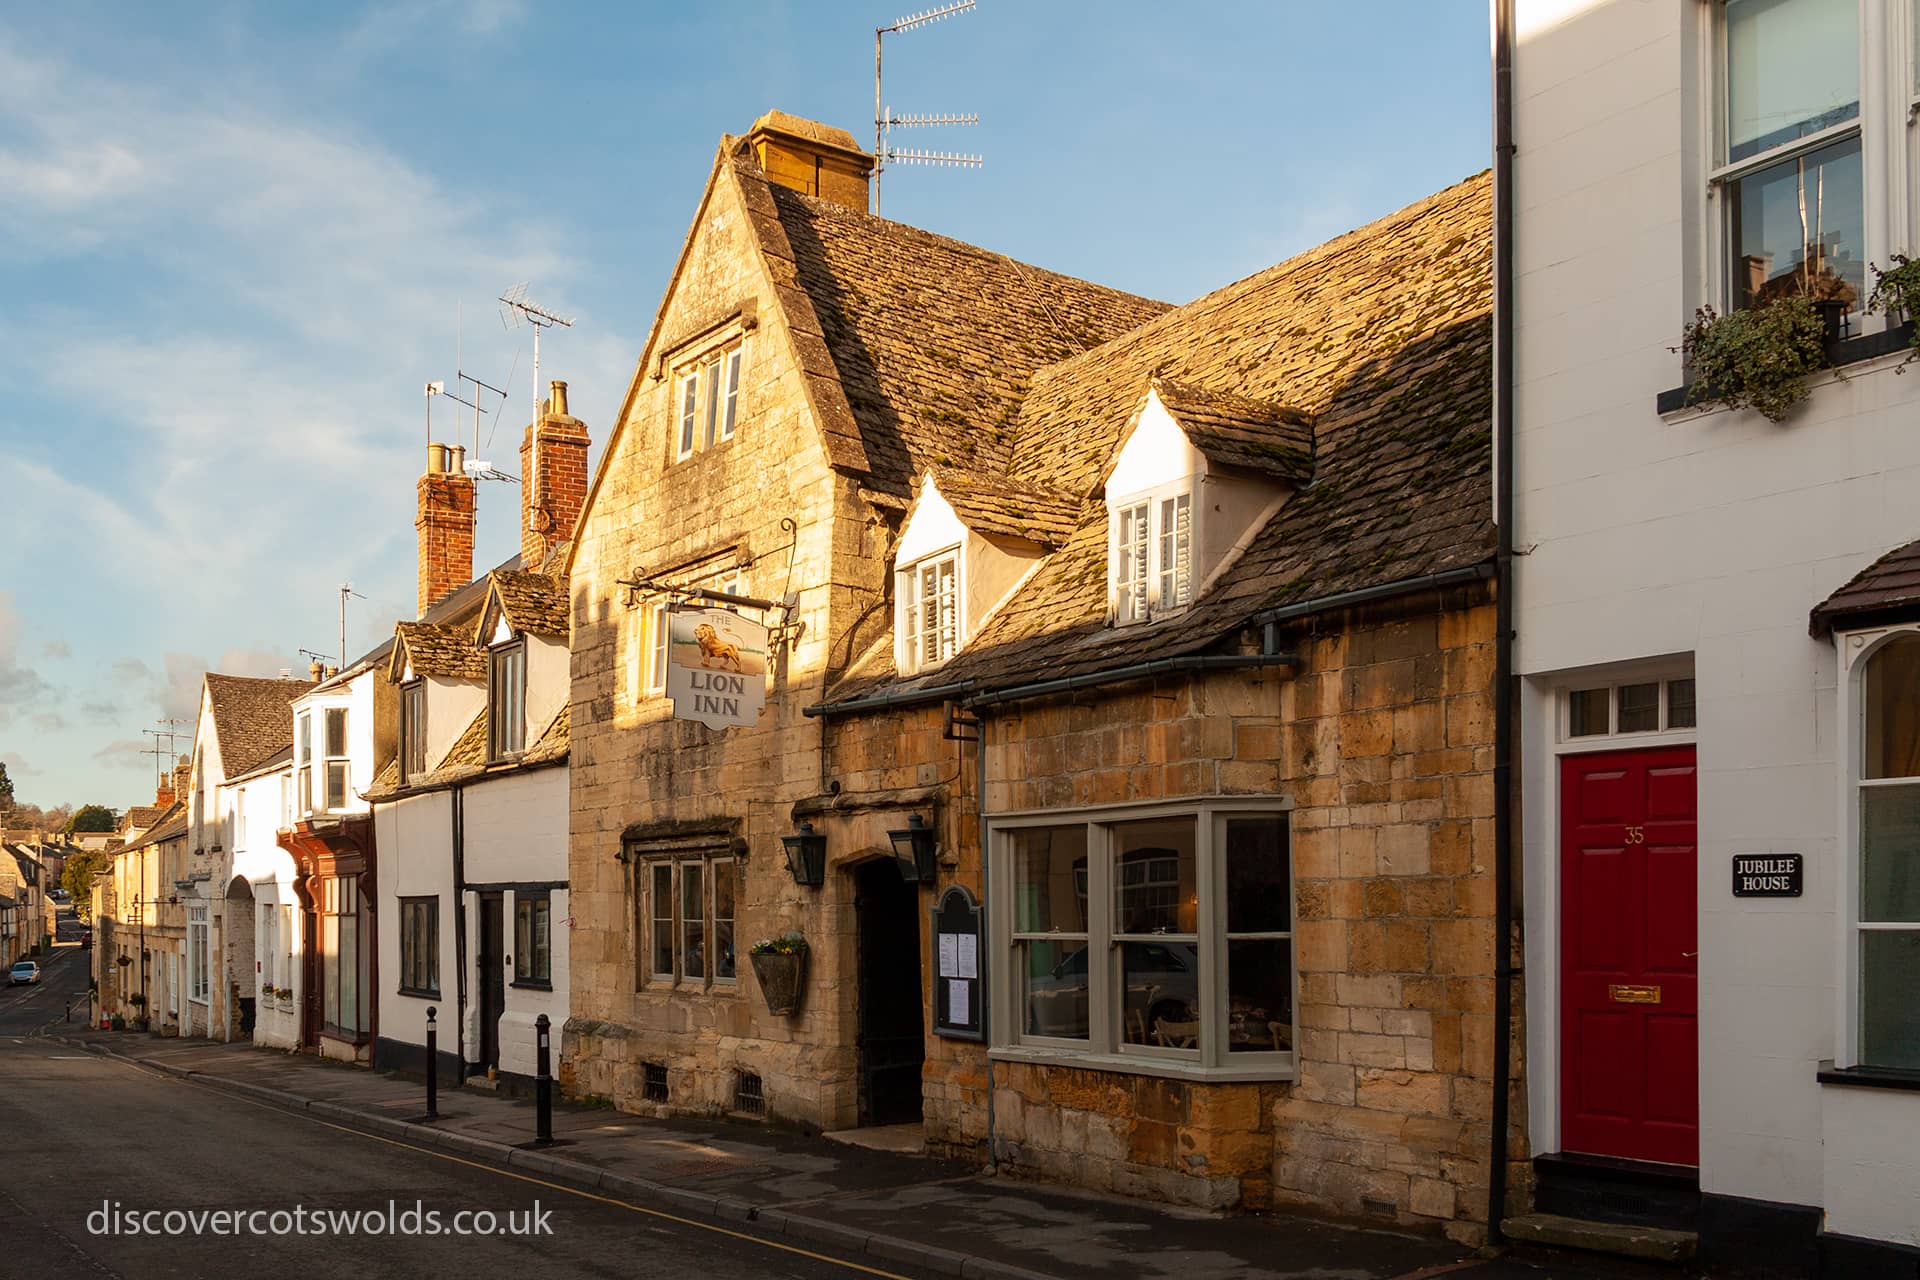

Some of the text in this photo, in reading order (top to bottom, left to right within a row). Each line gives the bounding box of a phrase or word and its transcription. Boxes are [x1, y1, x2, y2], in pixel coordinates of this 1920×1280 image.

[711, 614, 732, 626] THE
[690, 671, 745, 695] LION
[694, 694, 739, 717] INN
[1624, 826, 1644, 845] 35
[1737, 859, 1796, 875] JUBILEE
[1742, 876, 1791, 891] HOUSE
